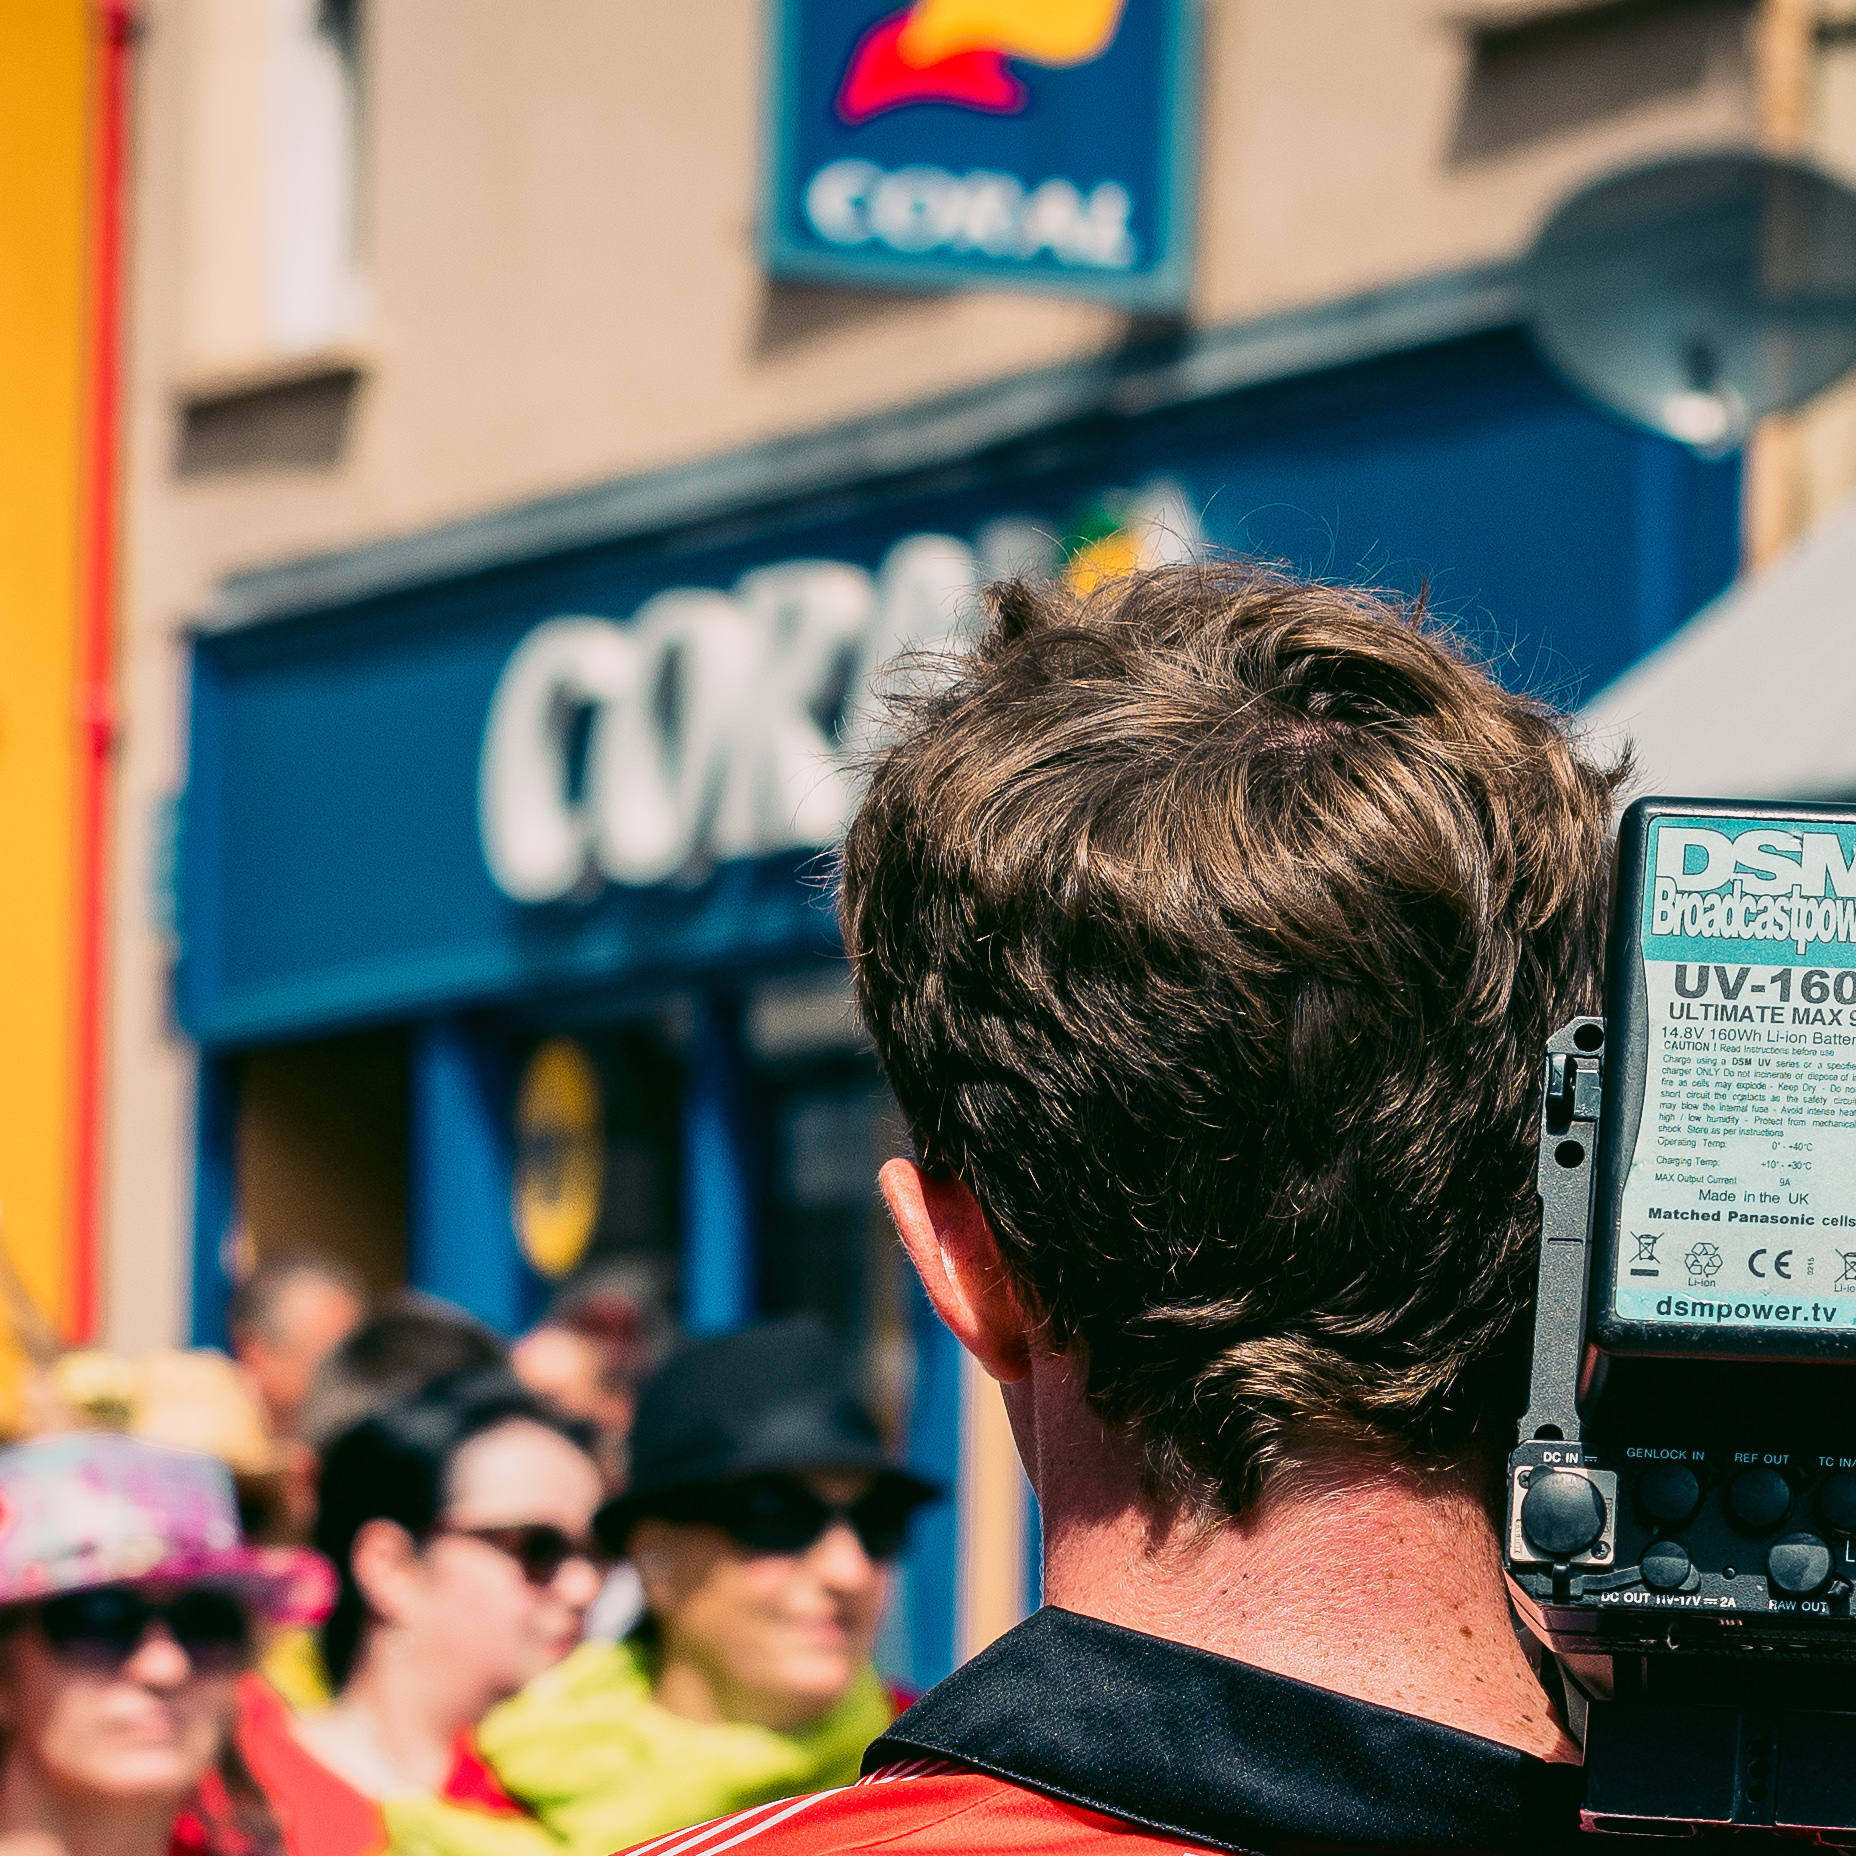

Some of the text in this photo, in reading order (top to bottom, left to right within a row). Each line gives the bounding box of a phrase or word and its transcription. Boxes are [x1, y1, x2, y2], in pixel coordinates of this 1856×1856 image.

[805, 158, 1138, 269] CORAL
[478, 515, 1052, 903] CORA
[1669, 1001, 1786, 1025] ULTIMATE
[1791, 1006, 1844, 1028] MAX
[1661, 1024, 1705, 1041] 14.8V
[1709, 1026, 1762, 1043] 160Wh
[1766, 1029, 1808, 1045] Li-ion
[1663, 1039, 1710, 1053] CAUTION
[1719, 1043, 1741, 1054] Read
[1791, 1046, 1818, 1057] before
[1819, 1049, 1835, 1057] use
[1662, 1053, 1692, 1066] Charge
[1696, 1055, 1718, 1067] using
[1731, 1056, 1753, 1067] DSM
[1757, 1057, 1772, 1068] UV
[1775, 1059, 1801, 1069] series
[1803, 1061, 1813, 1069] or
[1661, 1065, 1693, 1077] charger
[1695, 1066, 1721, 1078] ONLY
[1723, 1067, 1735, 1078] Do
[1737, 1069, 1751, 1079] not
[1753, 1069, 1792, 1081] incinerate
[1794, 1072, 1804, 1081] or
[1807, 1071, 1839, 1084] dispose
[1839, 1072, 1850, 1082] of
[1661, 1076, 1675, 1088] fire
[1677, 1079, 1688, 1087] as
[1691, 1077, 1710, 1089] cells
[1714, 1080, 1733, 1092] may
[1735, 1079, 1767, 1093] explode
[1777, 1081, 1799, 1094] Keep
[1802, 1082, 1817, 1096] Dry
[1829, 1083, 1842, 1094] Do
[1659, 1088, 1681, 1099] short
[1685, 1089, 1711, 1100] circuit
[1713, 1091, 1727, 1101] the
[1770, 1094, 1781, 1103] as
[1786, 1094, 1799, 1104] the
[1802, 1094, 1828, 1107] safety
[1659, 1101, 1677, 1112] may
[1680, 1100, 1700, 1112] blow
[1702, 1102, 1716, 1112] the
[1719, 1102, 1749, 1114] internal
[1751, 1104, 1769, 1115] fuse
[1780, 1104, 1804, 1117] Avoid
[1806, 1106, 1836, 1117] intense
[1838, 1108, 1856, 1117] heat
[1658, 1112, 1676, 1124] high
[1687, 1112, 1702, 1123] low
[1706, 1113, 1740, 1126] humidity
[1753, 1115, 1784, 1126] Protect
[1787, 1116, 1807, 1127] from
[1811, 1117, 1856, 1129] mechanical
[1657, 1123, 1785, 1138] shock Store as per instructions
[1656, 1135, 1697, 1150] Operating
[1655, 1154, 1693, 1168] Charging
[1654, 1172, 1791, 1188] MAX Output Current 9A
[1698, 1188, 1810, 1206] Made in the UK
[1648, 1207, 1856, 1228] Matched Panasonic cells
[1687, 1277, 1717, 1288] Li-ion
[1656, 1295, 1838, 1323] dsmpower.tv
[1543, 1451, 1579, 1464] DC IN
[1626, 1447, 1705, 1461] GENLOCK IN
[1734, 1452, 1790, 1465] REF OUT
[1818, 1456, 1834, 1467] TC
[1600, 1591, 1619, 1603] DC
[1623, 1592, 1650, 1604] OUT
[1719, 1596, 1737, 1608] 2A
[1768, 1599, 1828, 1613] RAW OUT
